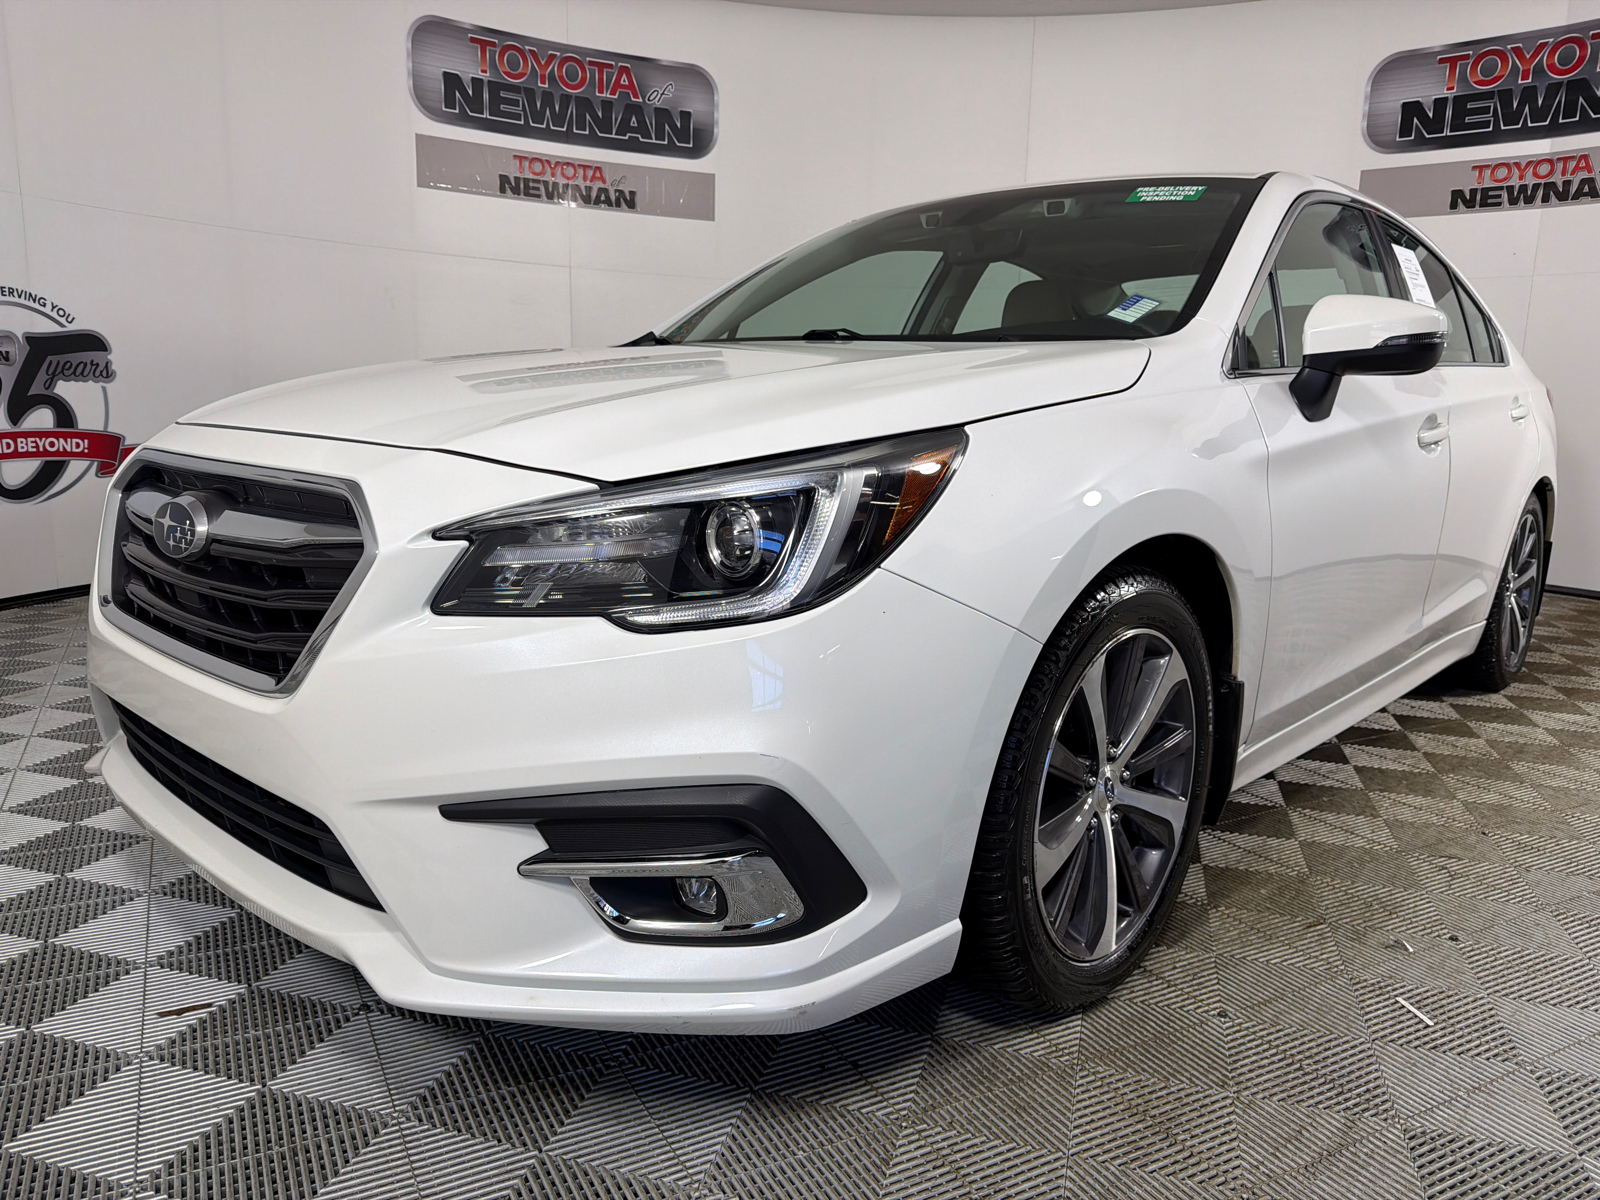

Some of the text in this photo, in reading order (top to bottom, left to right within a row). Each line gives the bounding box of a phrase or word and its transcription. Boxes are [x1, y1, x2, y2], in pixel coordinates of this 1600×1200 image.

[468, 34, 674, 104] TOYOTA of
[441, 70, 694, 148] NEWNAN
[513, 154, 627, 188] TOYOTA of
[1471, 153, 1595, 185] TOYOTA
[498, 174, 637, 210] NEWNAN
[50, 301, 76, 324] YOU
[43, 358, 114, 391] years
[17, 436, 89, 454] BEYOND!
